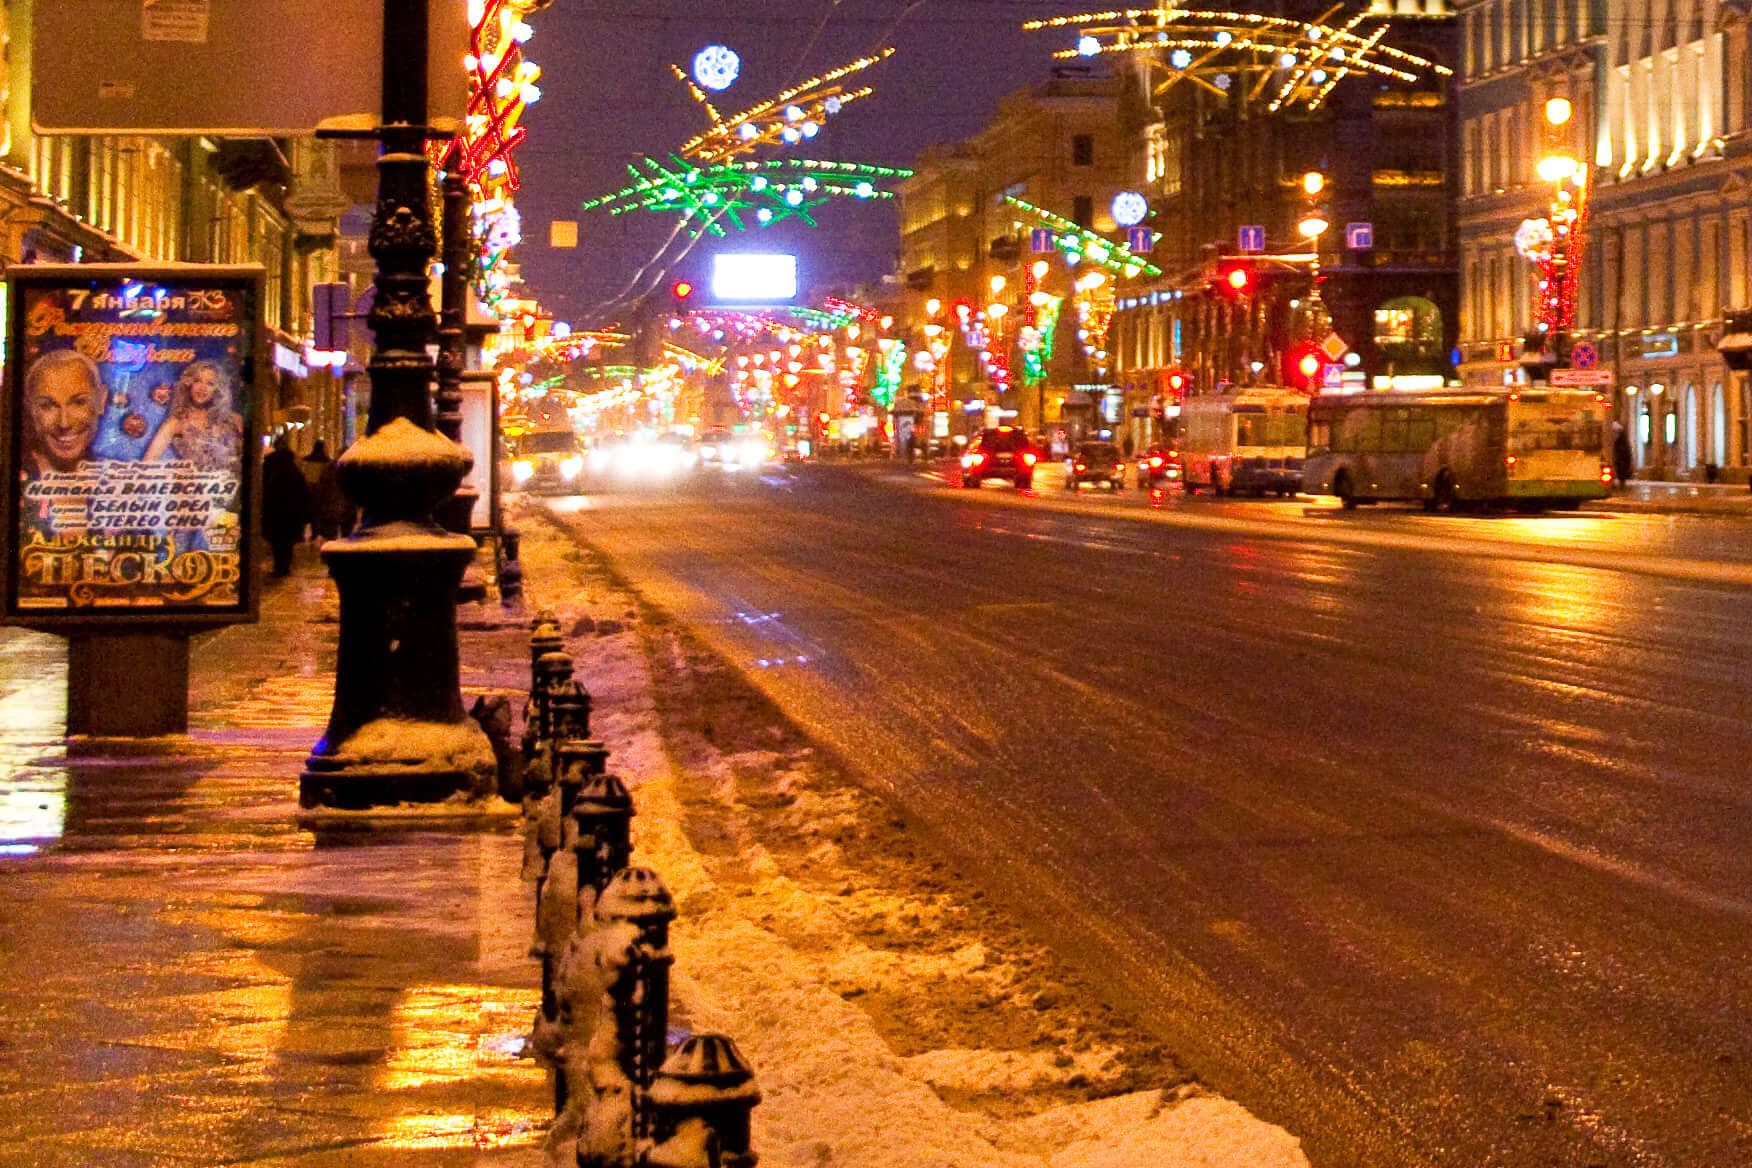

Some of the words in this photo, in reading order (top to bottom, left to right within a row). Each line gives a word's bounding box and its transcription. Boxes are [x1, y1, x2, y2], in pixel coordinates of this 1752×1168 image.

[67, 289, 90, 311] 7
[92, 293, 186, 315] января
[27, 483, 116, 496] Наталья
[120, 482, 237, 496] ВАЛЕВСКАЯ
[91, 514, 161, 528] STEREO
[27, 551, 240, 584] ПЕСКОВ
